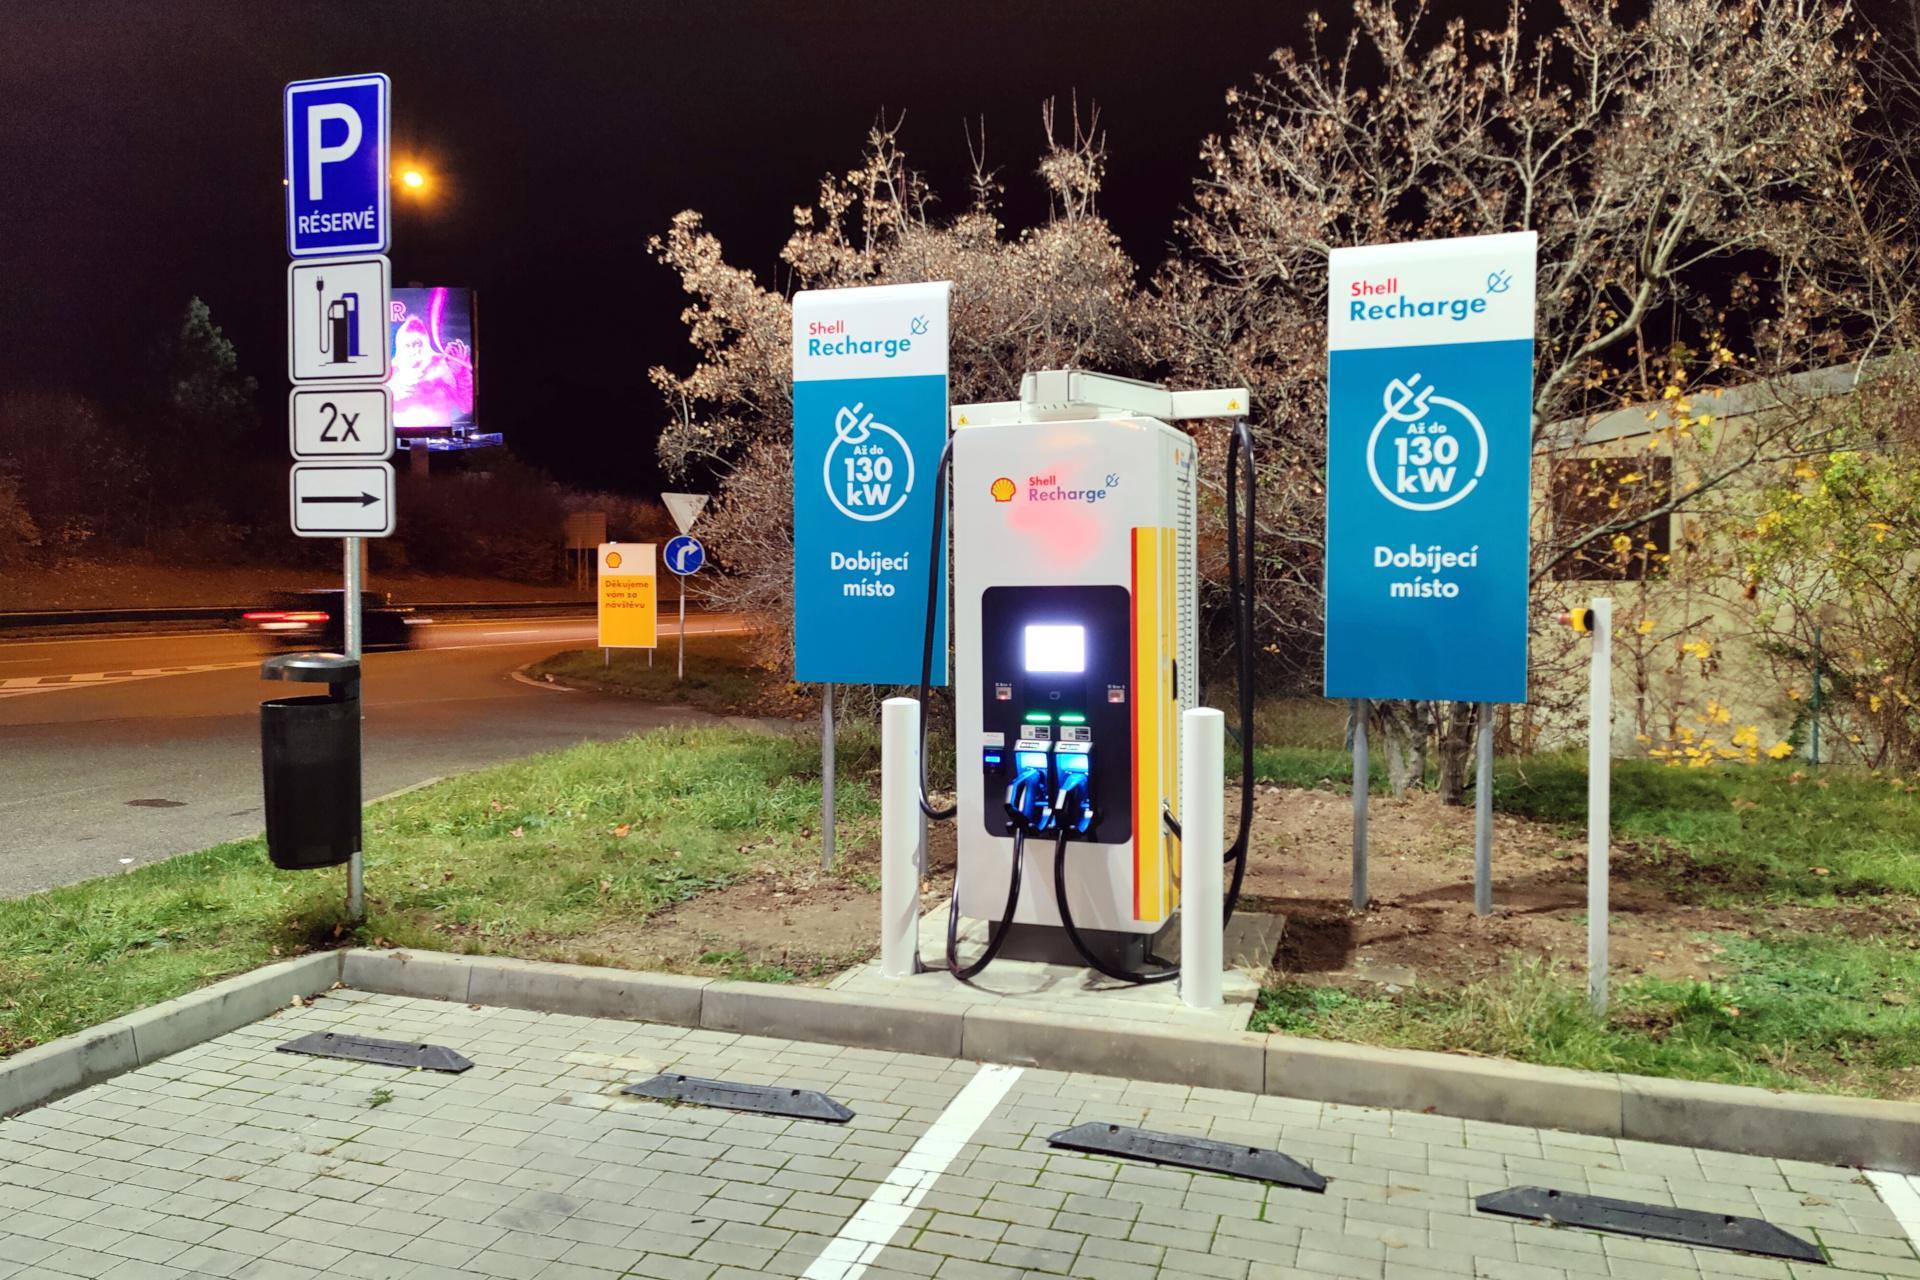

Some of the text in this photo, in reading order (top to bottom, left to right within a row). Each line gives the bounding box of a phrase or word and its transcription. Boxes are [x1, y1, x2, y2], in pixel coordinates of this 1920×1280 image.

[308, 103, 363, 201] P
[298, 205, 375, 234] RÉSERVÉ
[1351, 278, 1398, 296] Shell
[1350, 296, 1487, 321] Recharge
[809, 320, 844, 335] Shell
[809, 335, 911, 358] Recharge
[319, 402, 361, 442] 2x
[1406, 422, 1447, 434] Až do
[853, 444, 884, 455] Až do
[1394, 435, 1459, 466] 130
[844, 456, 893, 482] 130
[1029, 475, 1056, 486] Shell
[1396, 466, 1457, 493] kW
[847, 483, 892, 506] kW
[1029, 486, 1106, 503] Recharge
[831, 550, 909, 576] Dobíjecí
[1374, 544, 1479, 574] Dobíjecí
[843, 578, 895, 597] místo
[1390, 576, 1459, 598] místo
